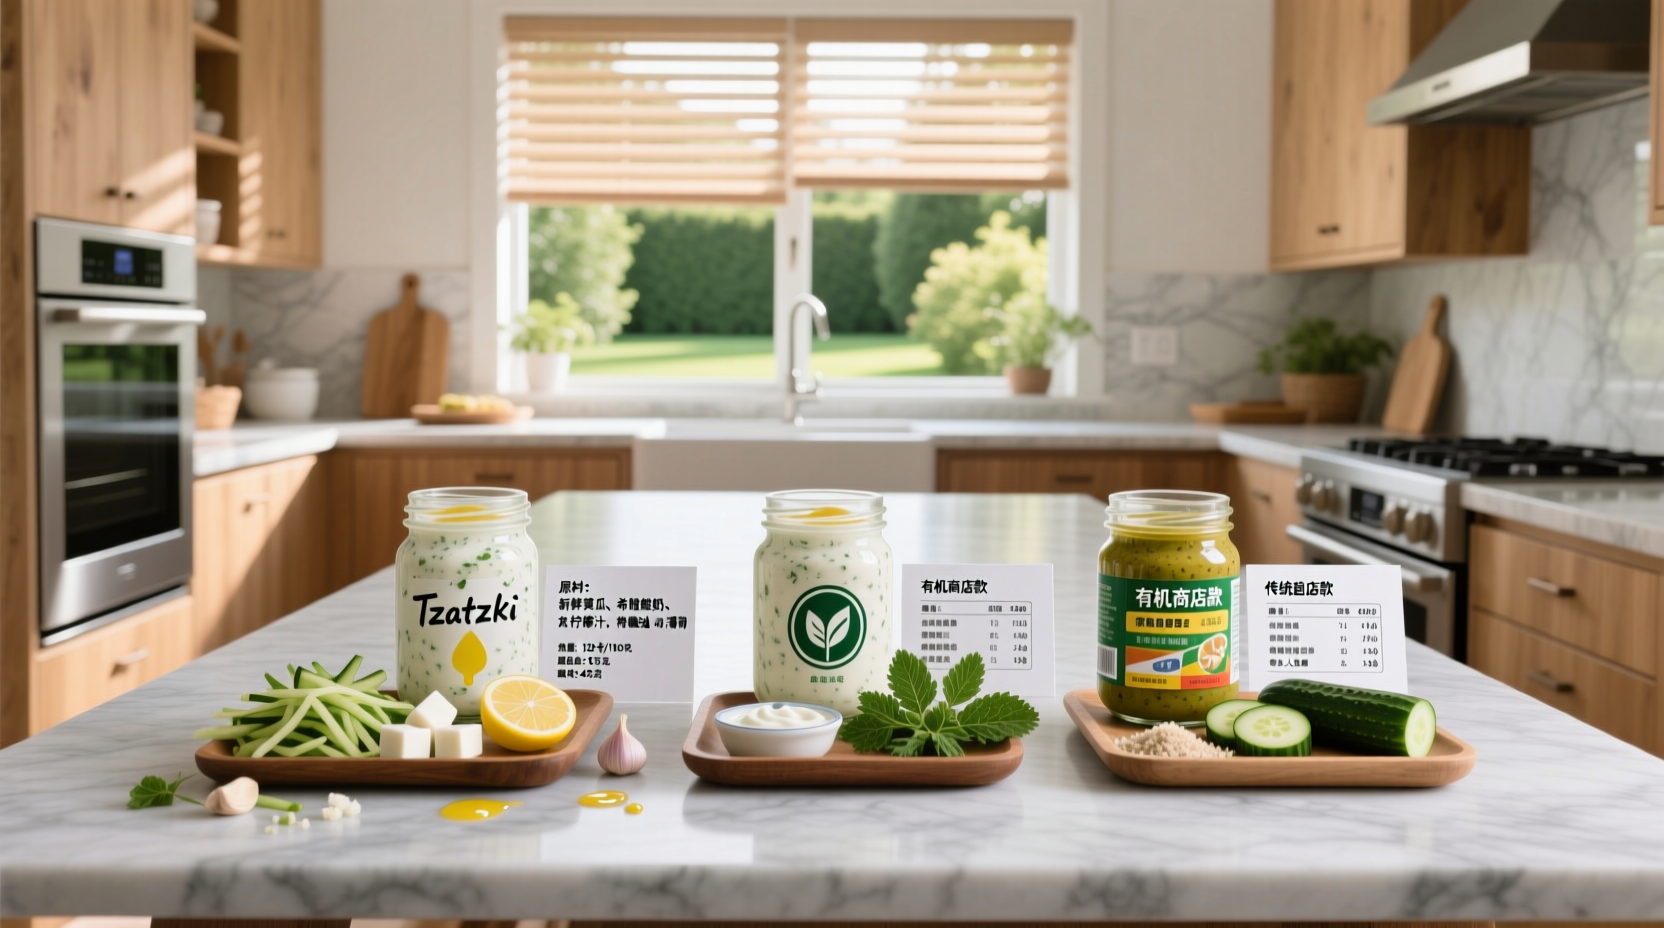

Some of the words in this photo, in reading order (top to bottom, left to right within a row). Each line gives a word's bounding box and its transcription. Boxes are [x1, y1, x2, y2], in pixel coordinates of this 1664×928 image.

[412, 592, 519, 628] Tzatzki
[1135, 586, 1223, 609] 有机商店款
